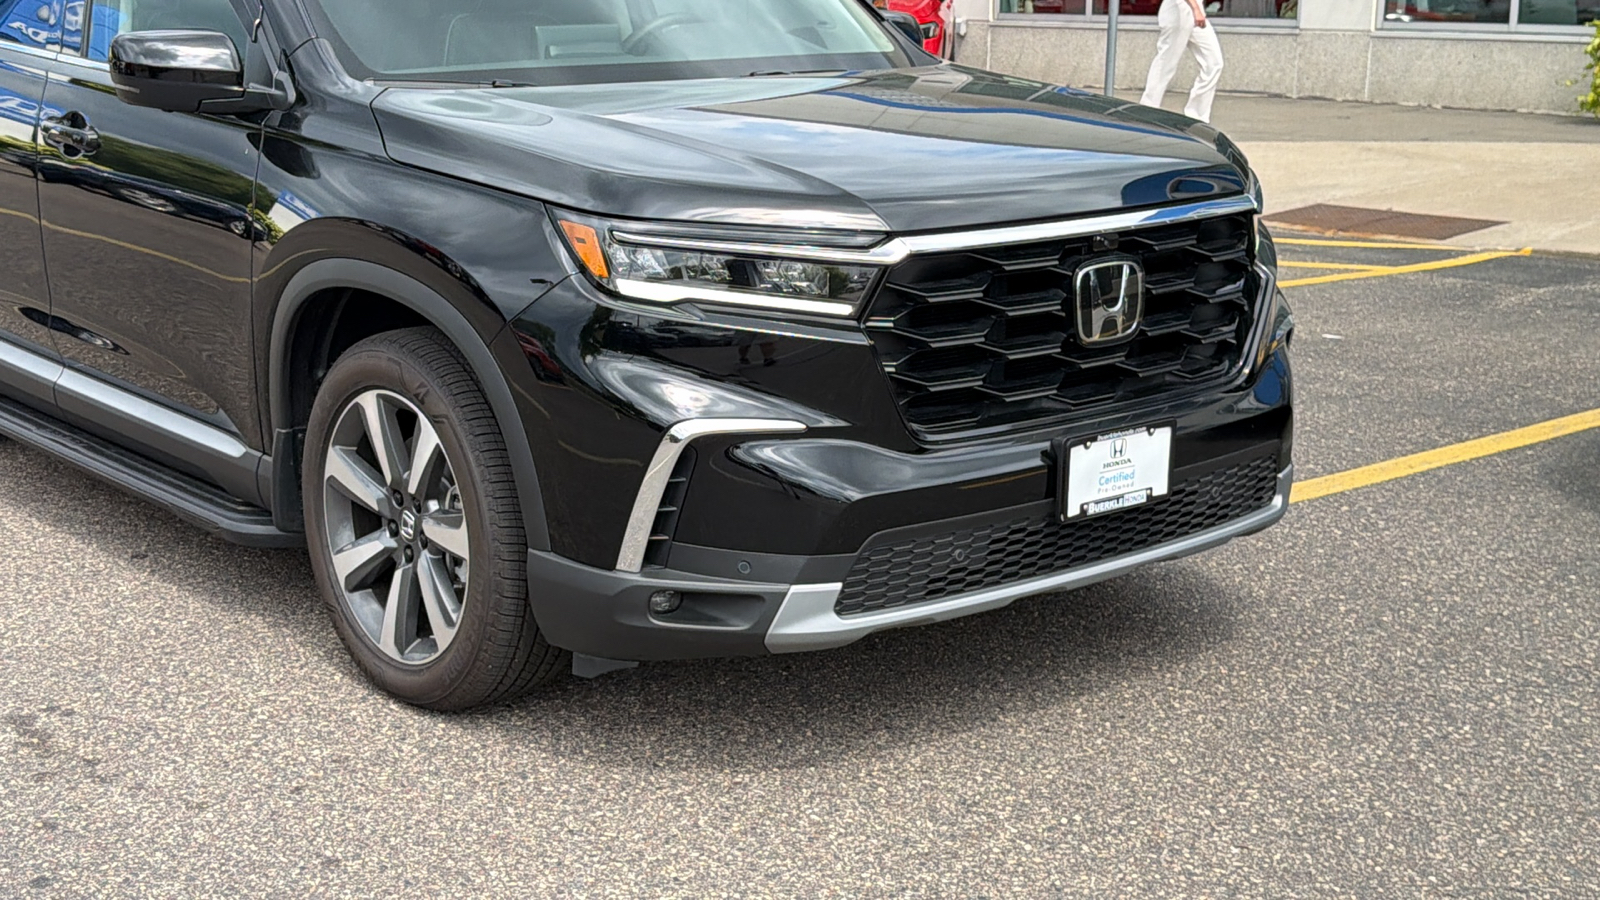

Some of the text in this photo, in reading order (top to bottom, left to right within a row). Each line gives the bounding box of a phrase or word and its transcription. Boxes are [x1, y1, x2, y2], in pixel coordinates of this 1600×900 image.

[1102, 458, 1132, 469] HONDA
[1099, 469, 1135, 486] Certified
[1097, 481, 1134, 494] Pre-Owned
